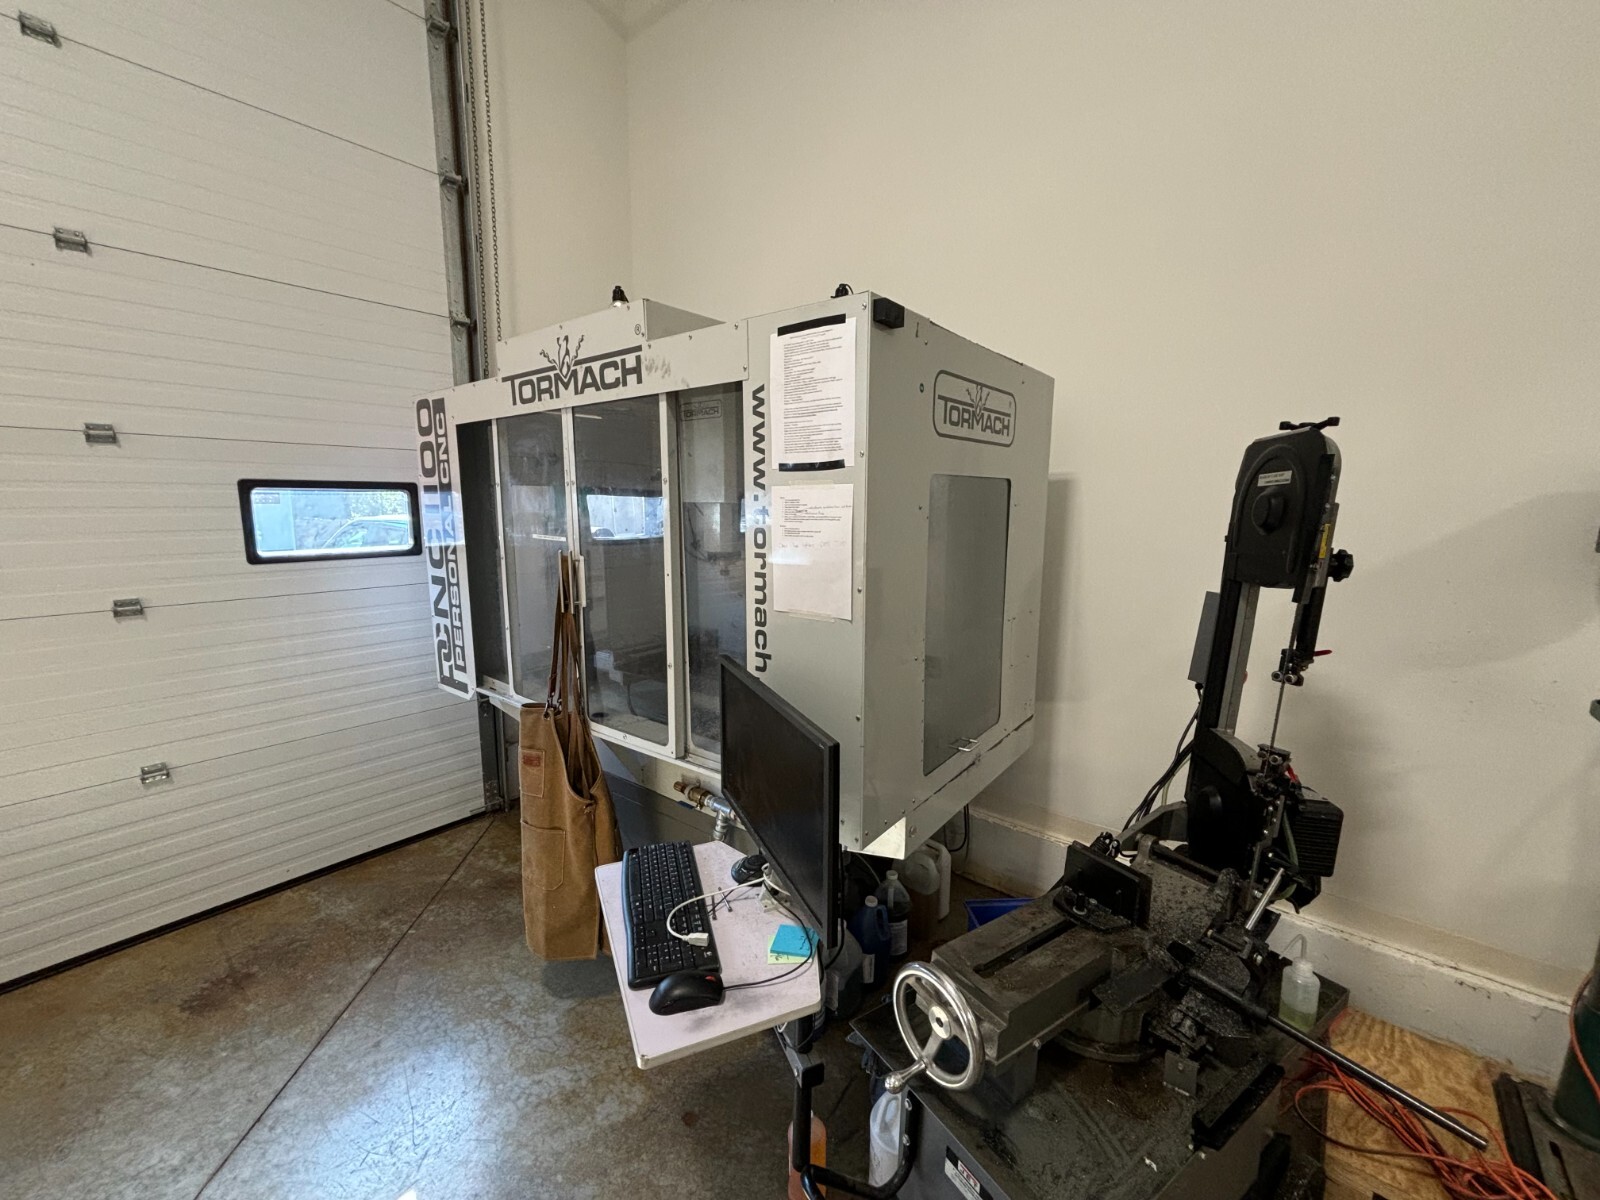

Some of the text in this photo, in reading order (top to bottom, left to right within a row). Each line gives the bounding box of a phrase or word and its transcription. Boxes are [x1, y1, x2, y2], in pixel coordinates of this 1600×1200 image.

[501, 344, 643, 406] TORMACH
[937, 393, 1012, 437] TORMACH
[435, 411, 465, 667] PERSONAL CNC
[427, 526, 469, 693] PCNC
